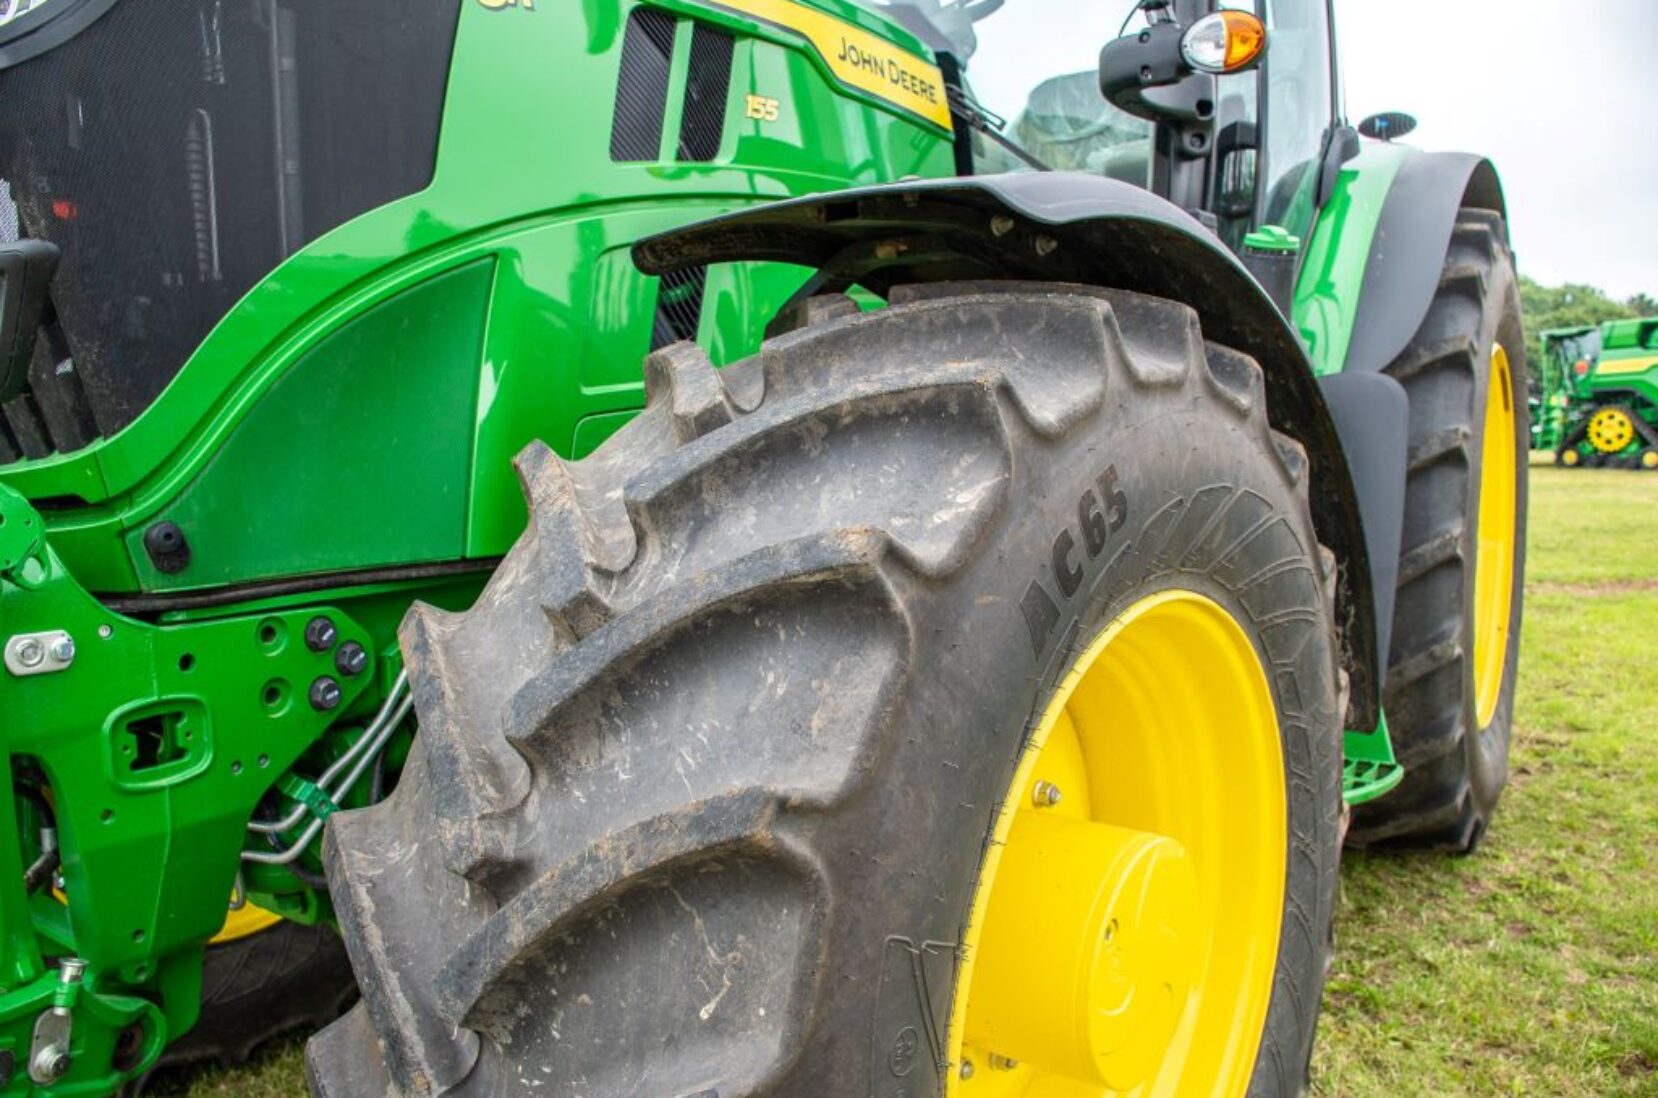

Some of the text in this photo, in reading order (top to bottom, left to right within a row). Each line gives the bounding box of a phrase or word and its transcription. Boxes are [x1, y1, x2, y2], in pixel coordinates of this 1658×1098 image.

[838, 36, 938, 105] JOHN DEERE
[744, 93, 779, 121] 155
